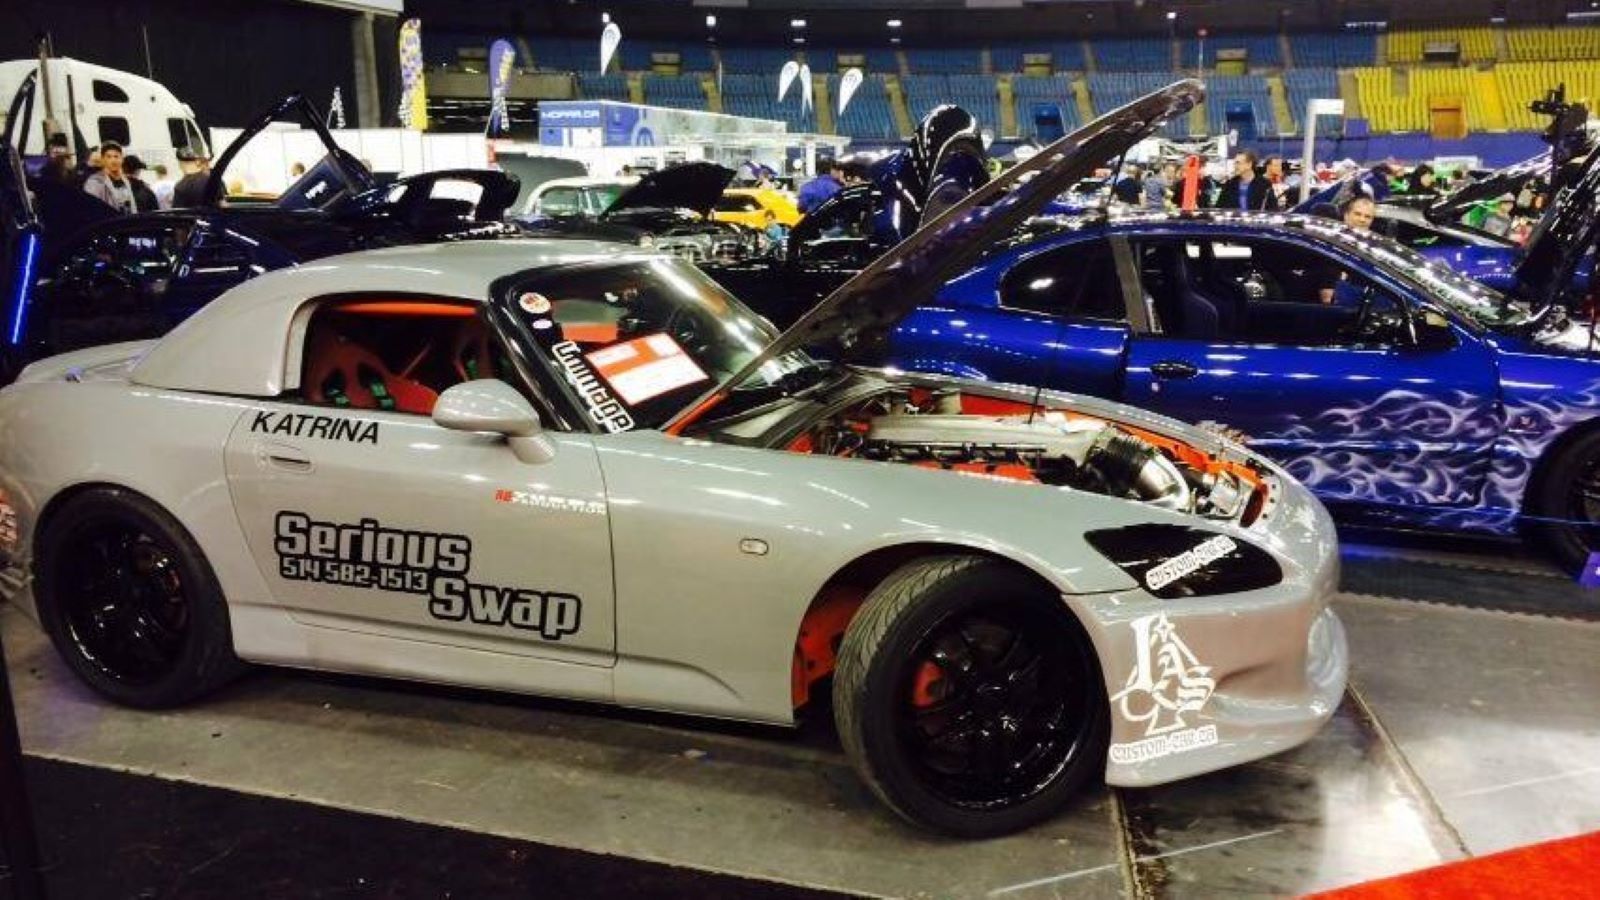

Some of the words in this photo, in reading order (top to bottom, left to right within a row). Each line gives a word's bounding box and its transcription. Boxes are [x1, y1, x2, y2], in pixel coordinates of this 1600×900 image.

[251, 410, 379, 444] KATRINA
[274, 511, 472, 574] Serious
[280, 559, 321, 581] 514
[324, 563, 430, 593] 582-1513
[429, 574, 582, 640] Swap
